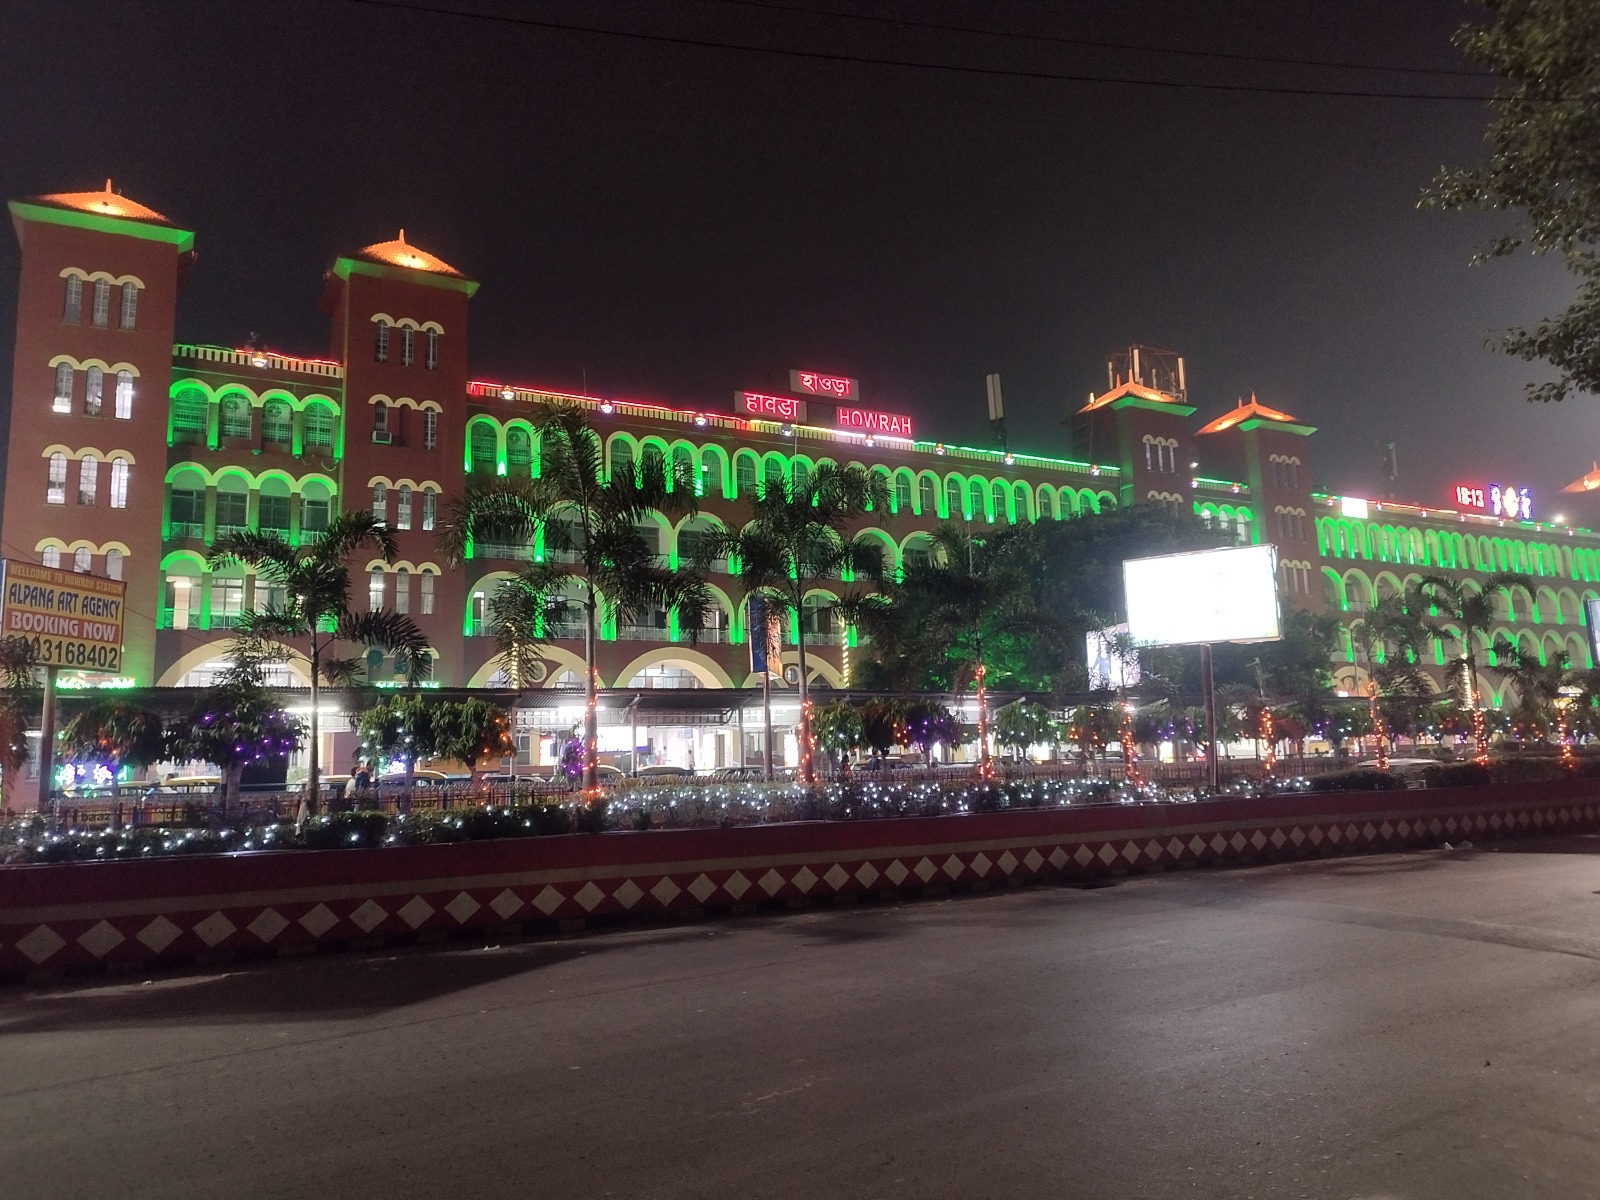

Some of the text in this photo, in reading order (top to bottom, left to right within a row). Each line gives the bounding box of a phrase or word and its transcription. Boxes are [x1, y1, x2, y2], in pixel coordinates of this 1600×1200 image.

[801, 373, 851, 396] হাওড়া
[745, 392, 799, 419] हावड़ा
[839, 409, 912, 434] HOWRAH
[9, 583, 121, 620] ALPANA ART AGENCY
[11, 611, 116, 642] BOOKING NOW
